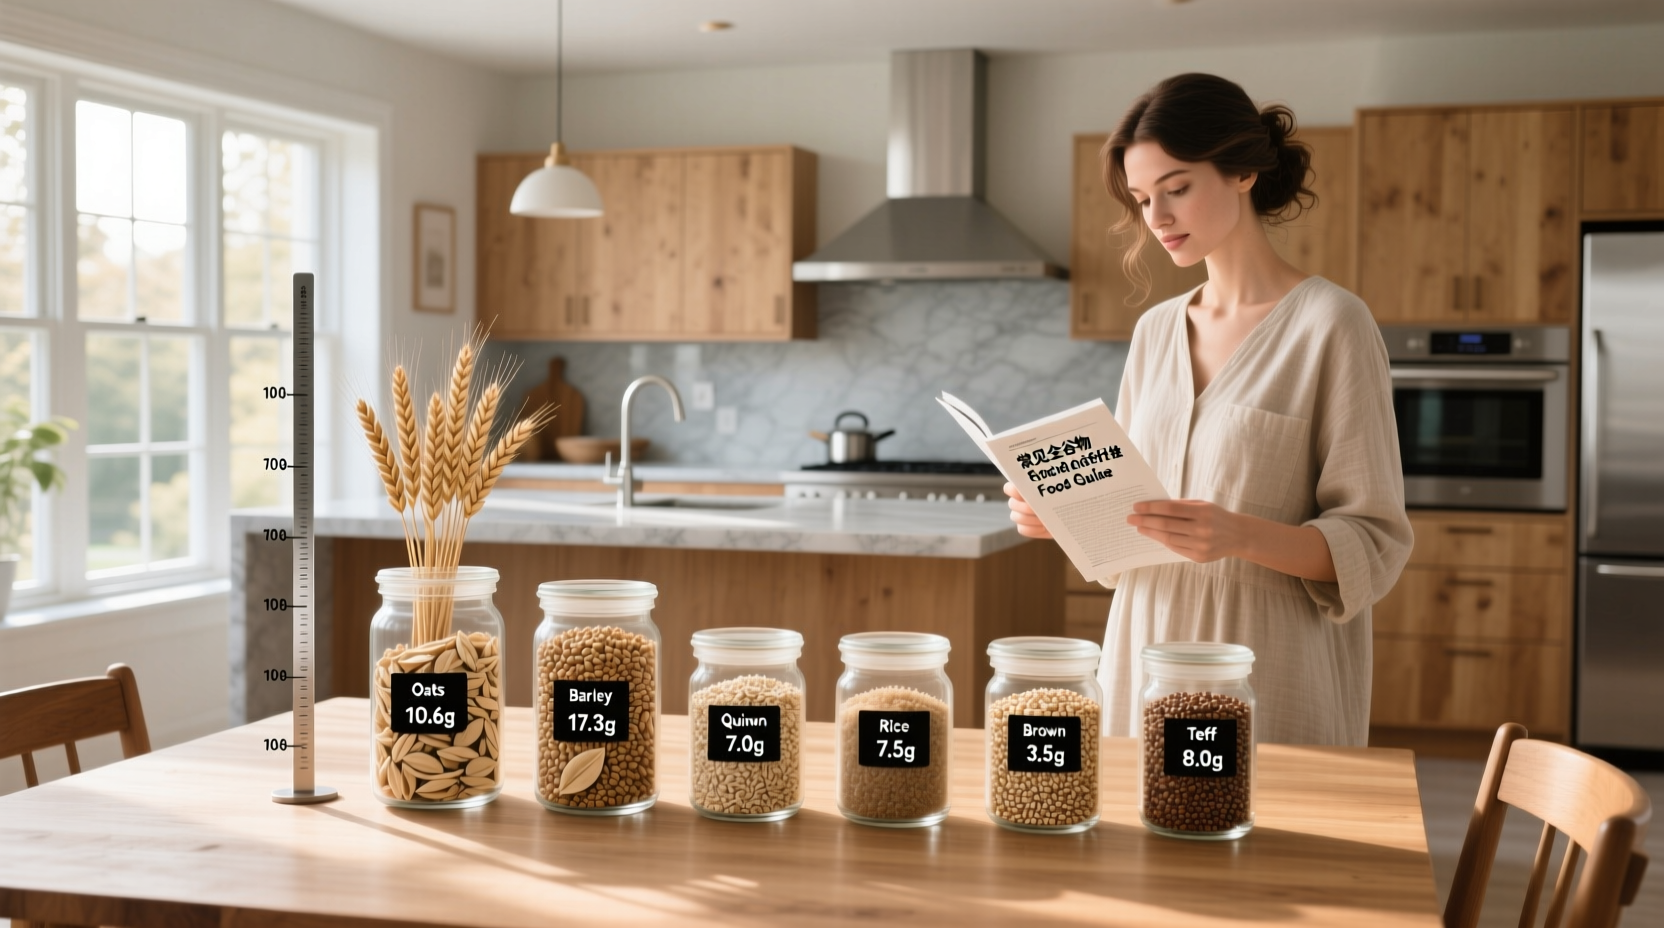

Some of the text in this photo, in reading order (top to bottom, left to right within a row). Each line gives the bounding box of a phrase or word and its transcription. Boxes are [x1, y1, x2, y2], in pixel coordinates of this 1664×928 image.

[411, 681, 445, 697] Oats
[569, 688, 613, 706] Barley
[405, 706, 456, 729] 10.6g
[568, 713, 616, 737] 17.3g
[879, 718, 910, 733] Rice
[1023, 723, 1066, 738] Brown
[1186, 726, 1218, 742] Teff
[725, 734, 764, 757] 7.0g
[876, 739, 916, 763] 7.5g
[1026, 744, 1065, 767] 3.5g
[1182, 749, 1223, 772] 8.0g
